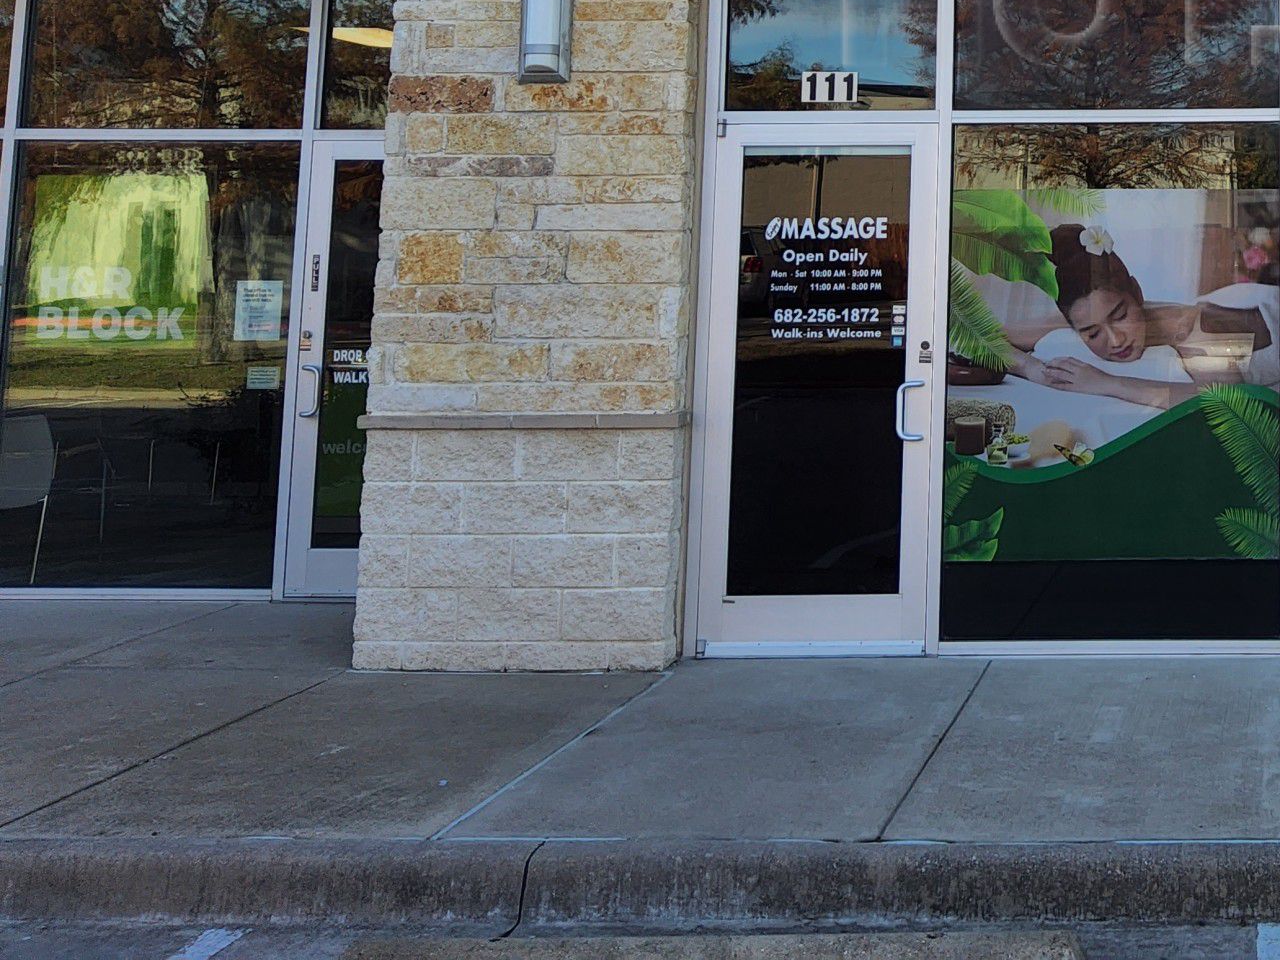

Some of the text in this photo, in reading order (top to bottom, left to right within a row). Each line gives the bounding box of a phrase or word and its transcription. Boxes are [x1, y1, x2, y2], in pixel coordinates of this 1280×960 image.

[806, 73, 856, 101] 111
[781, 217, 888, 239] MASSAGE
[783, 248, 868, 265] Open Daily
[771, 269, 787, 278] Mon
[795, 269, 807, 278] Sat
[811, 269, 832, 278] 10:00
[833, 269, 846, 278] AM
[852, 269, 869, 278] 9:00
[870, 269, 882, 278] PM
[40, 266, 132, 299] H&R
[770, 283, 798, 293] Sunday
[810, 282, 831, 291] 11:00
[833, 282, 846, 291] AM
[851, 282, 868, 291] 8:00
[870, 282, 882, 291] PM
[36, 306, 185, 340] BLOCK
[774, 308, 879, 323] 682-256-1872
[771, 327, 823, 338] Walk-ins
[827, 327, 882, 338] Welcome
[333, 349, 363, 362] DROP
[333, 371, 368, 384] WALK
[322, 439, 366, 454] welc
